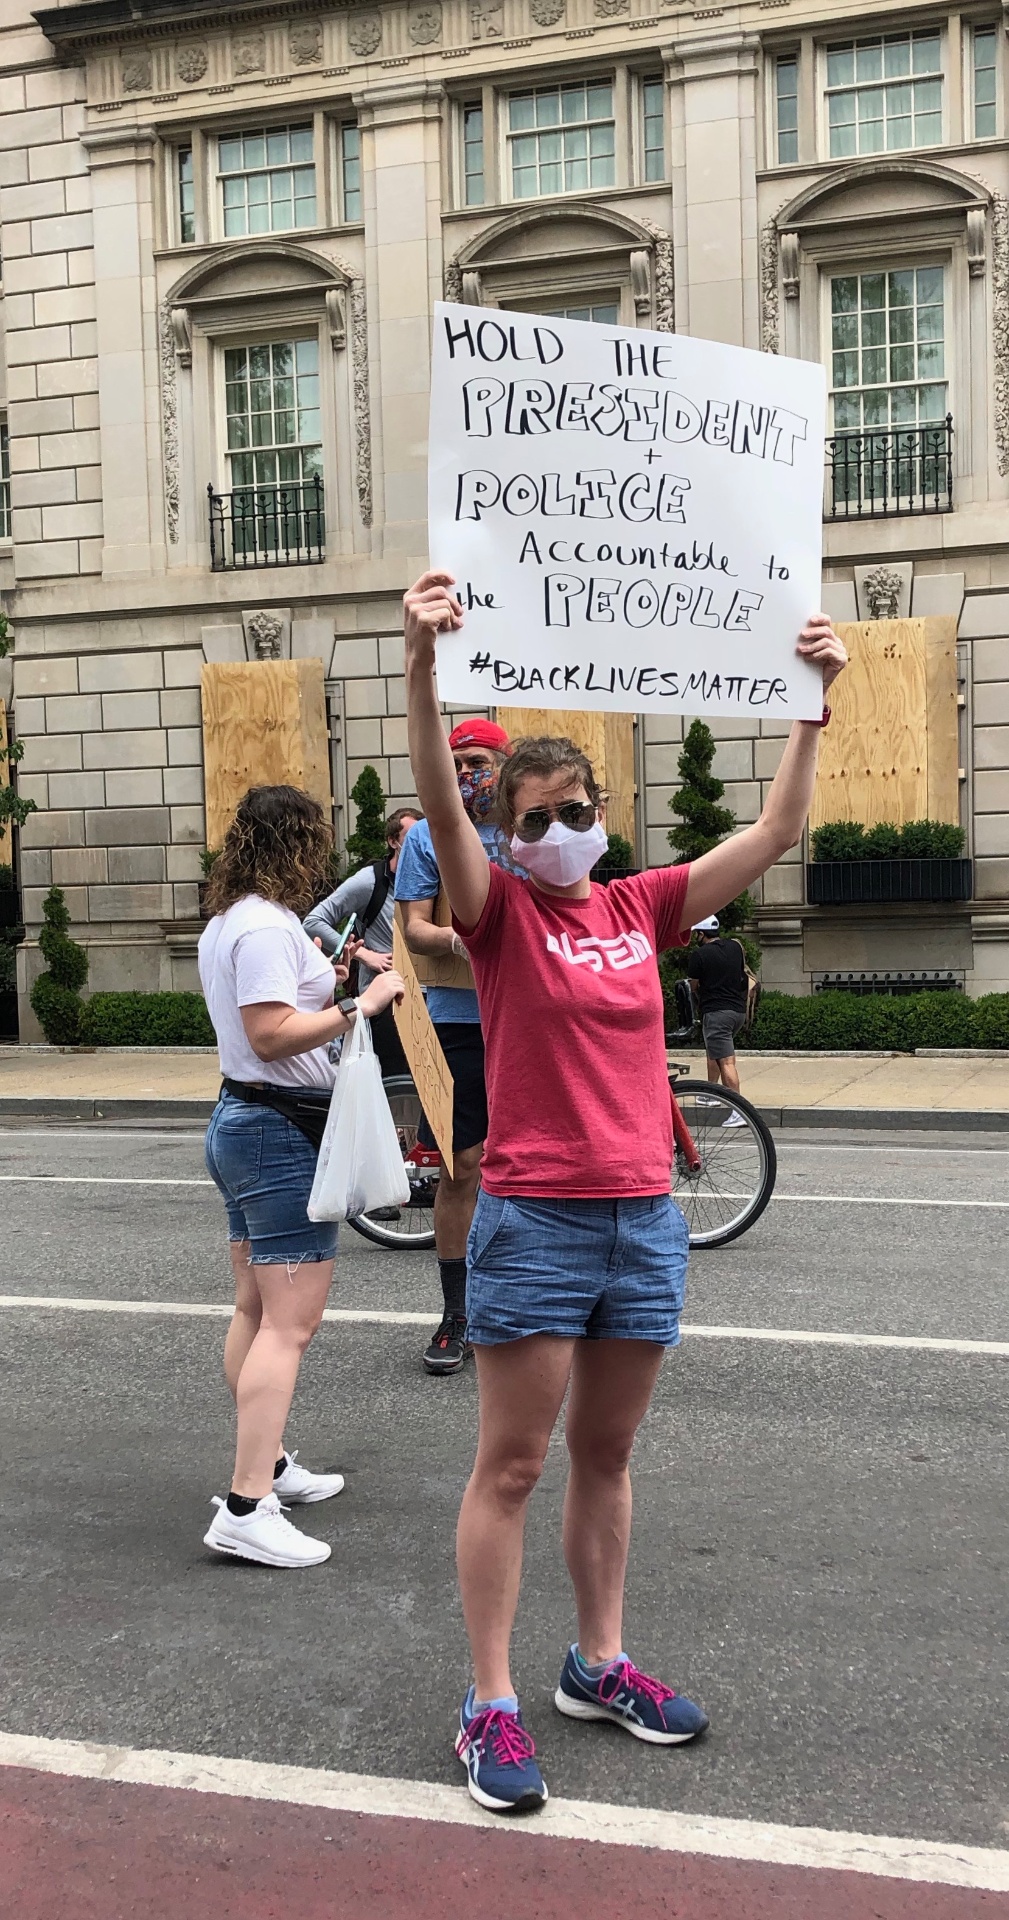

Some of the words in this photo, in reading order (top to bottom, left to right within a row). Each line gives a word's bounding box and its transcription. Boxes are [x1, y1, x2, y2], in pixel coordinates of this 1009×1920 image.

[444, 317, 564, 365] HOLD
[603, 338, 677, 380] THE
[462, 376, 808, 466] PRESIDENT
[643, 448, 662, 464] +
[455, 469, 691, 524] POLICE
[518, 530, 738, 578] Accountable
[763, 555, 790, 580] to
[544, 573, 764, 631] PEOPLE
[468, 651, 789, 705] #BLACKLIVESMATTER
